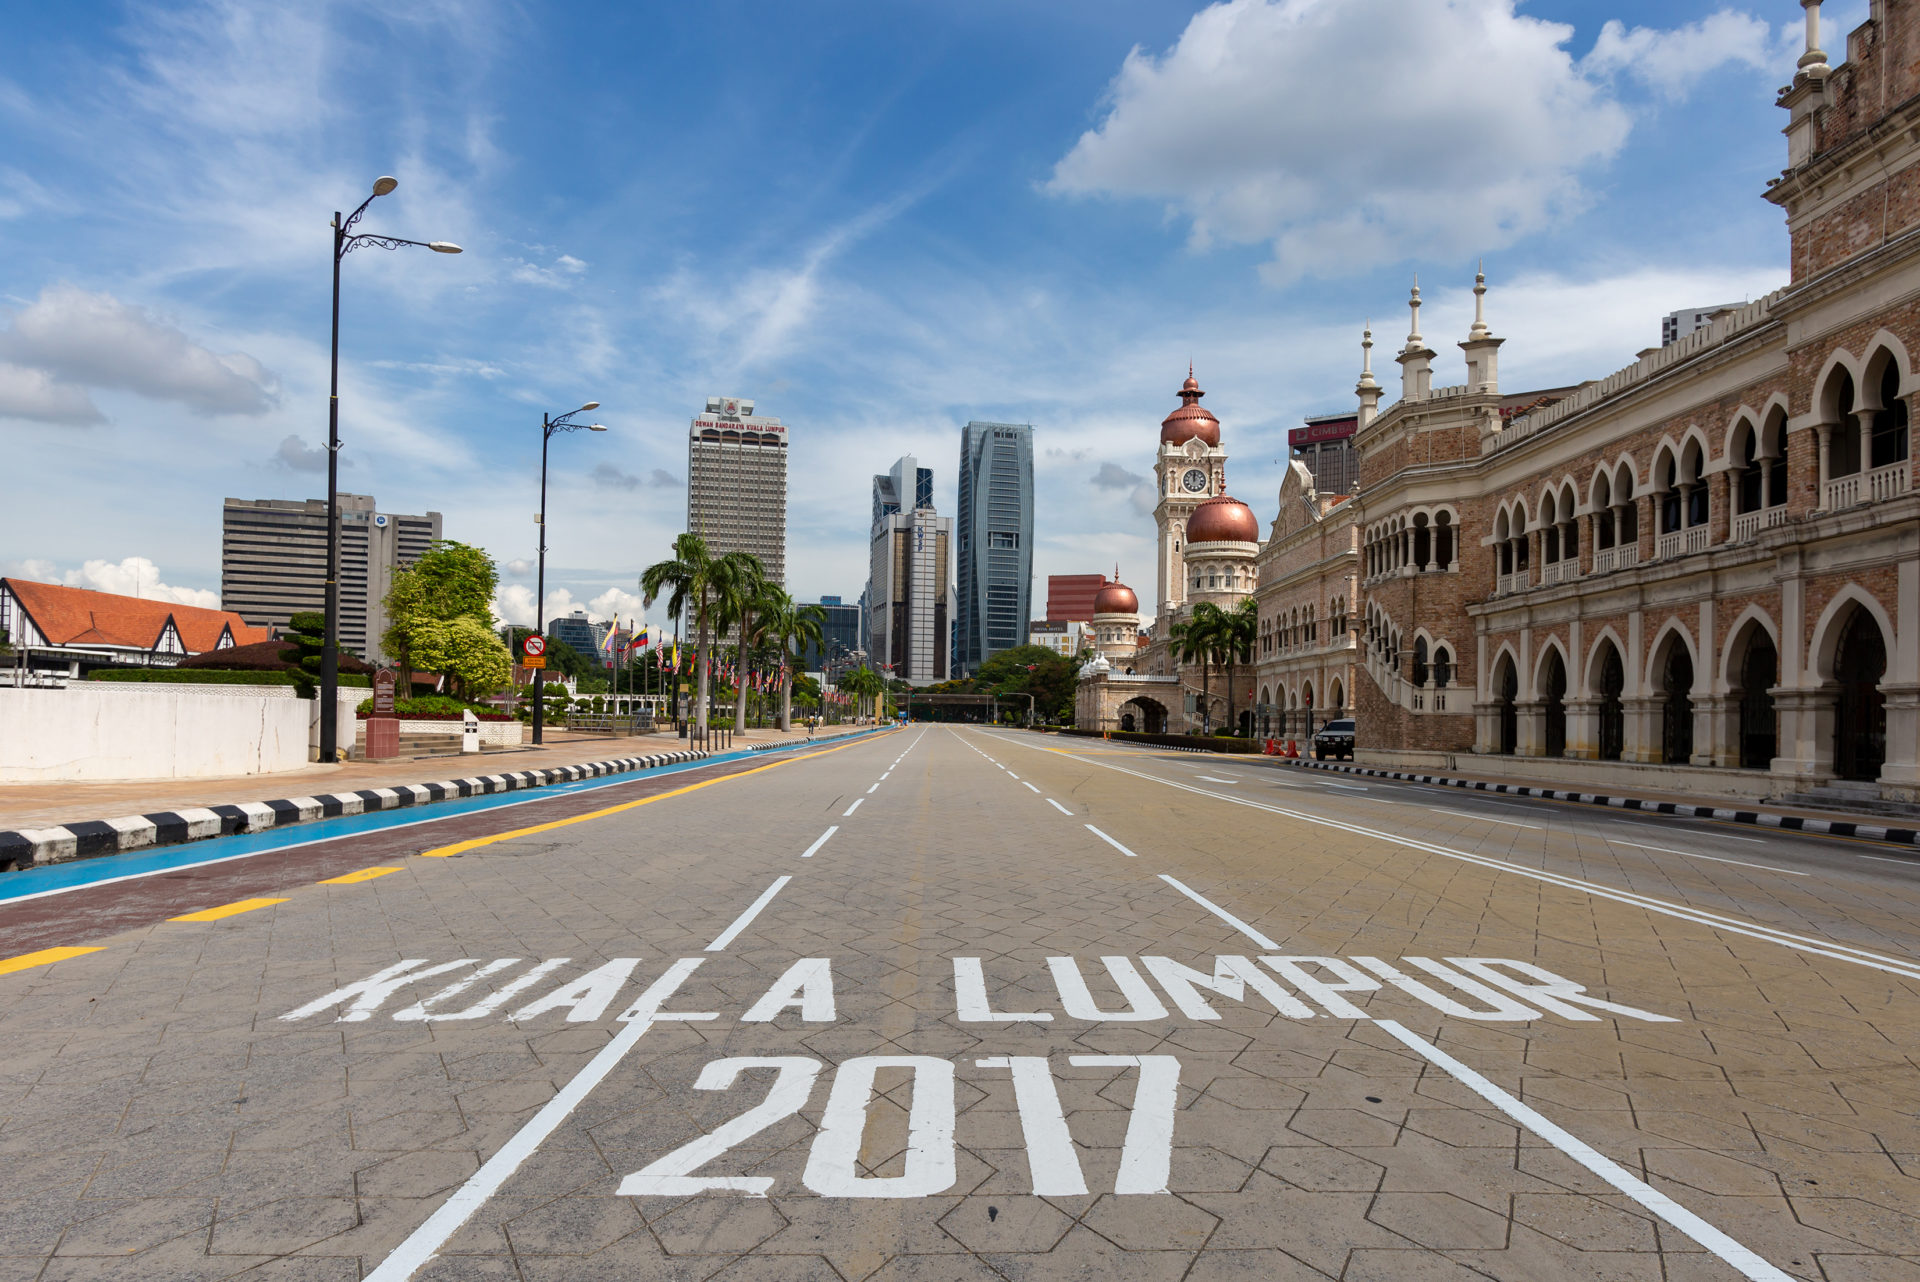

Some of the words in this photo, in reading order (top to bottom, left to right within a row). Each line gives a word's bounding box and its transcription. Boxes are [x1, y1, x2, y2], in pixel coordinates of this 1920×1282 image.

[715, 422, 745, 431] BANDARAYA
[747, 424, 764, 432] KUALA
[1311, 426, 1337, 437] CIMB
[278, 957, 836, 1023] KUALA
[953, 955, 1682, 1022] LUMPUR
[615, 1055, 1181, 1198] 2017
